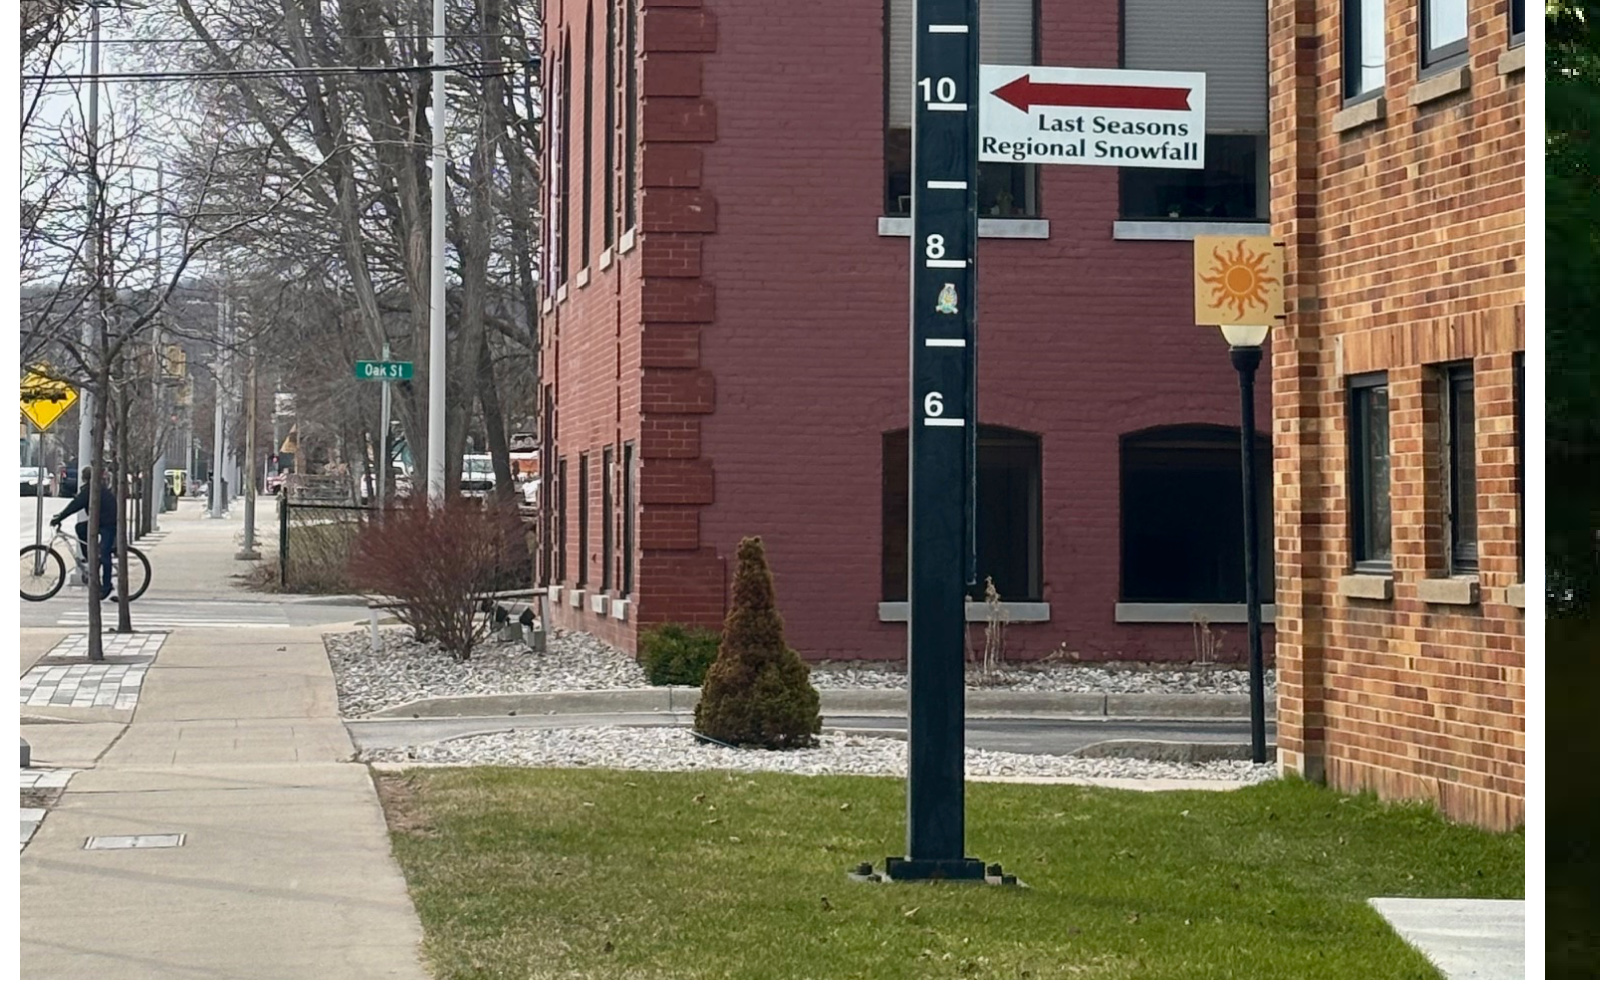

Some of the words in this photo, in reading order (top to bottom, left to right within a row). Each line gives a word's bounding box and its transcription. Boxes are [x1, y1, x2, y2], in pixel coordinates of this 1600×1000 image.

[917, 77, 957, 102] 10
[1038, 113, 1086, 133] Last
[1091, 115, 1189, 137] Seasons
[981, 136, 1086, 161] Regional
[1093, 139, 1198, 161] Snowfall
[925, 234, 946, 260] 8
[364, 363, 387, 377] Oak
[389, 364, 403, 378] St
[924, 391, 944, 417] 6
